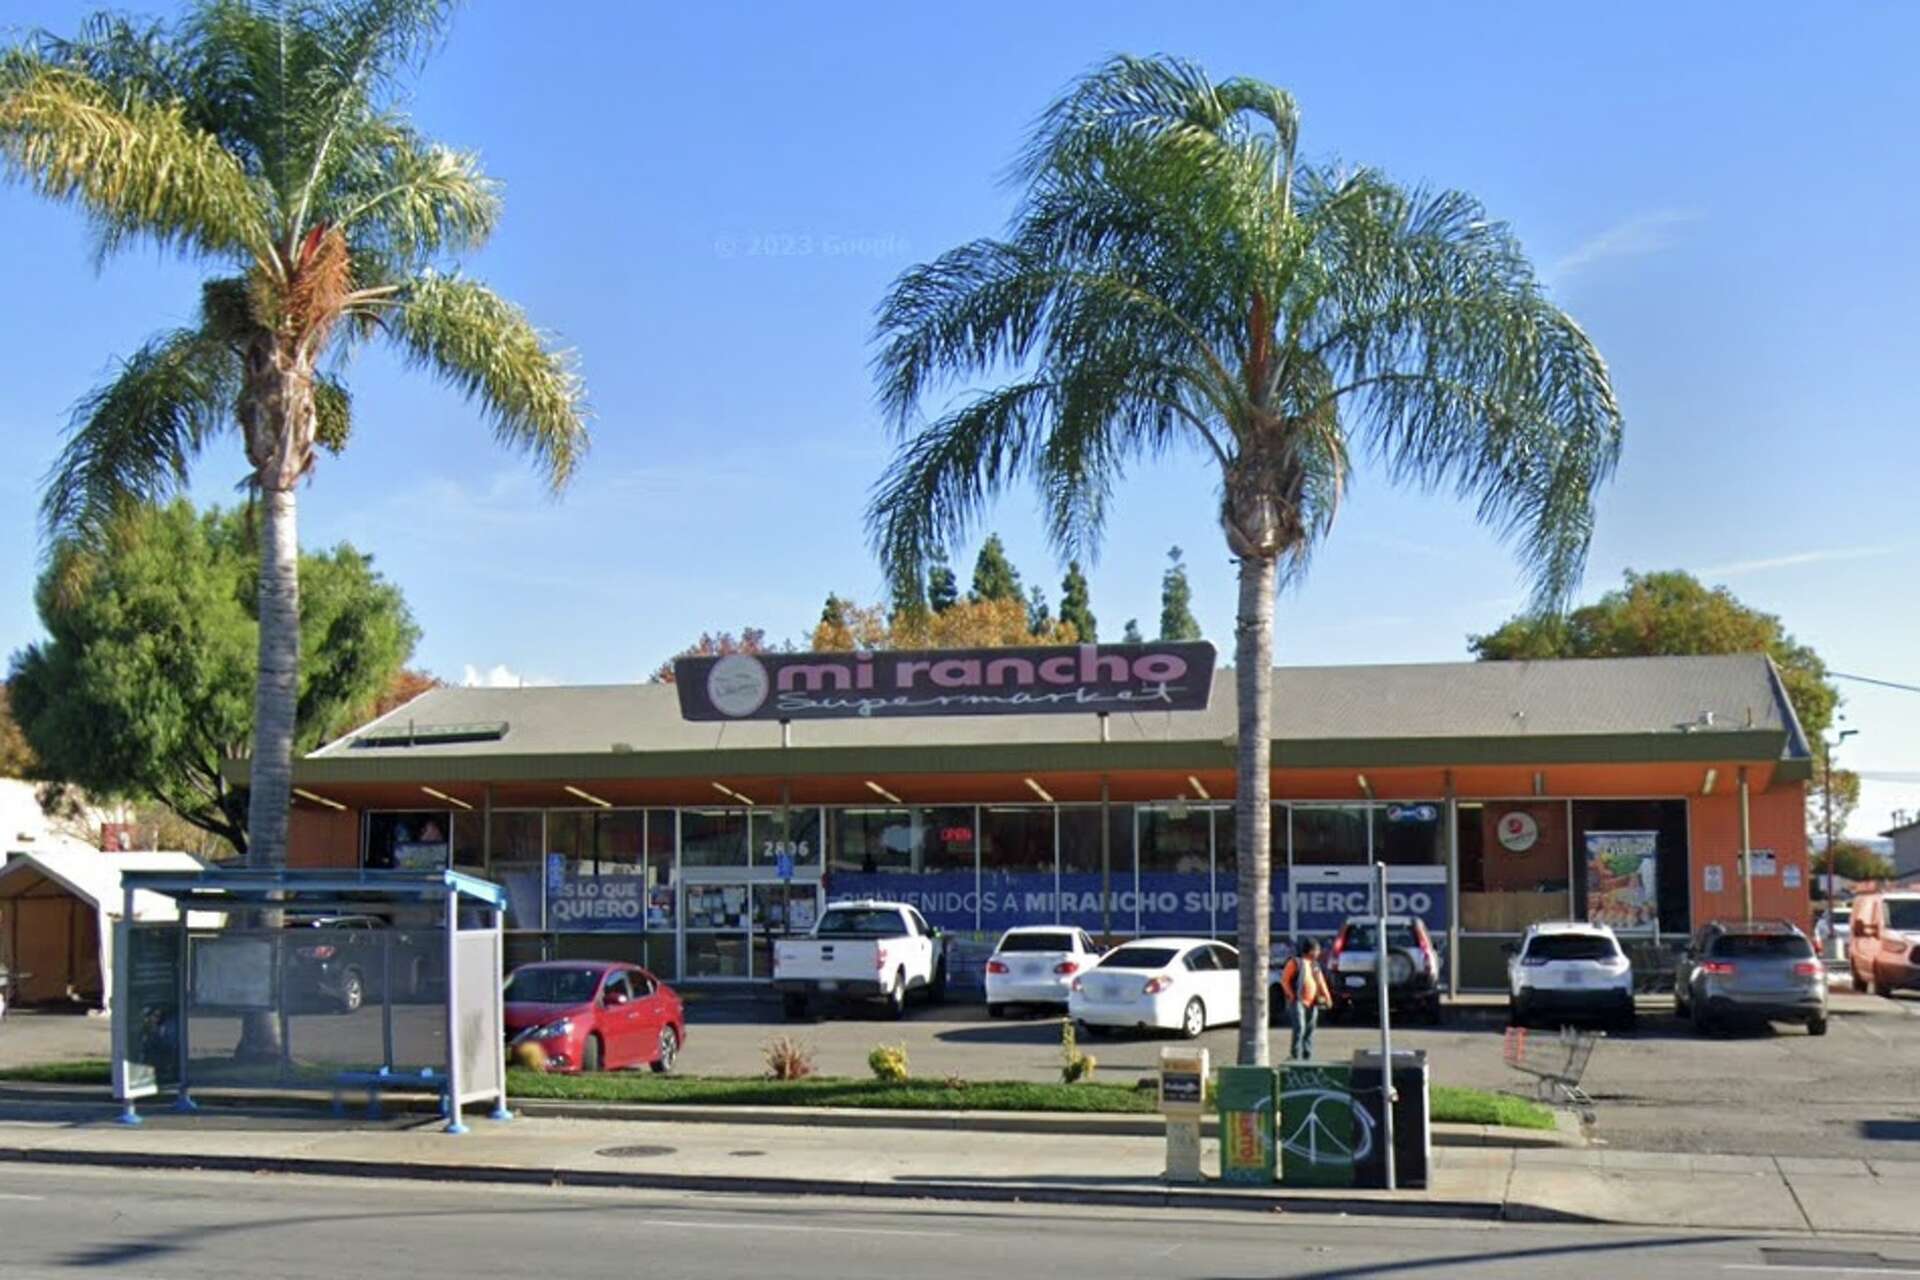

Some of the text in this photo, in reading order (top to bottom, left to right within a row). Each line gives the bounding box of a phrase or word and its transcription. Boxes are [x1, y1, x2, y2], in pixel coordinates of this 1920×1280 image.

[777, 644, 1188, 690] mi rancho
[777, 682, 1188, 717] Supermarket
[558, 882, 637, 899] S LO QUE
[552, 899, 640, 921] QUIERO
[1003, 892, 1019, 912] A
[1184, 891, 1275, 913] SUP
